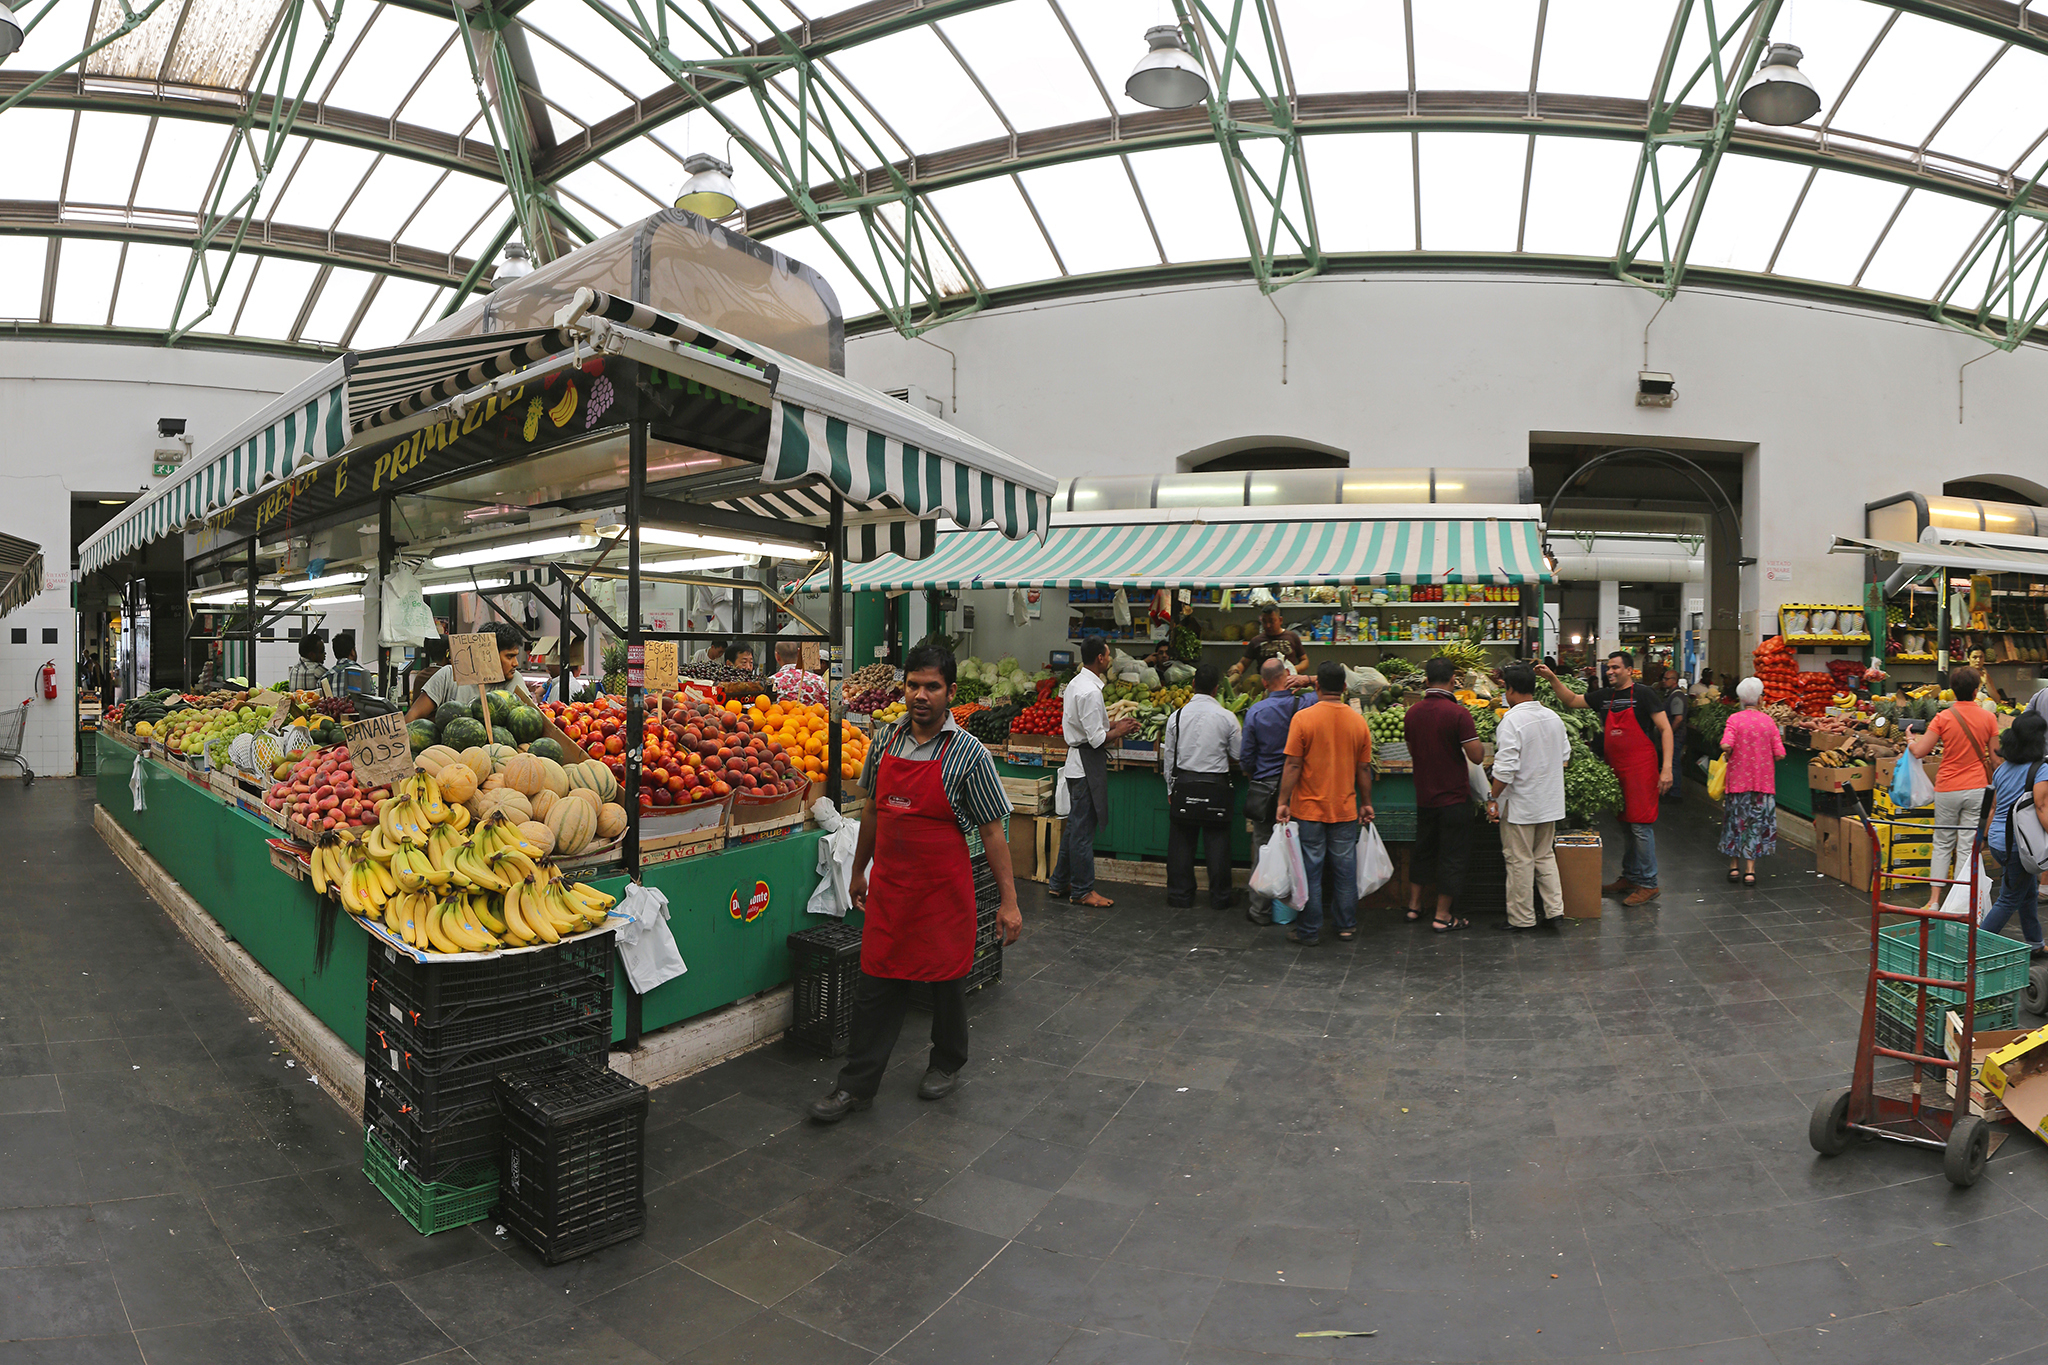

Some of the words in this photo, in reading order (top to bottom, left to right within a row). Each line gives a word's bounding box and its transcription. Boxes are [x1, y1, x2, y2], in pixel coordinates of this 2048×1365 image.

[334, 456, 348, 498] E
[452, 634, 490, 645] MELONI
[645, 642, 674, 655] PESCHE
[344, 712, 401, 742] BANANE
